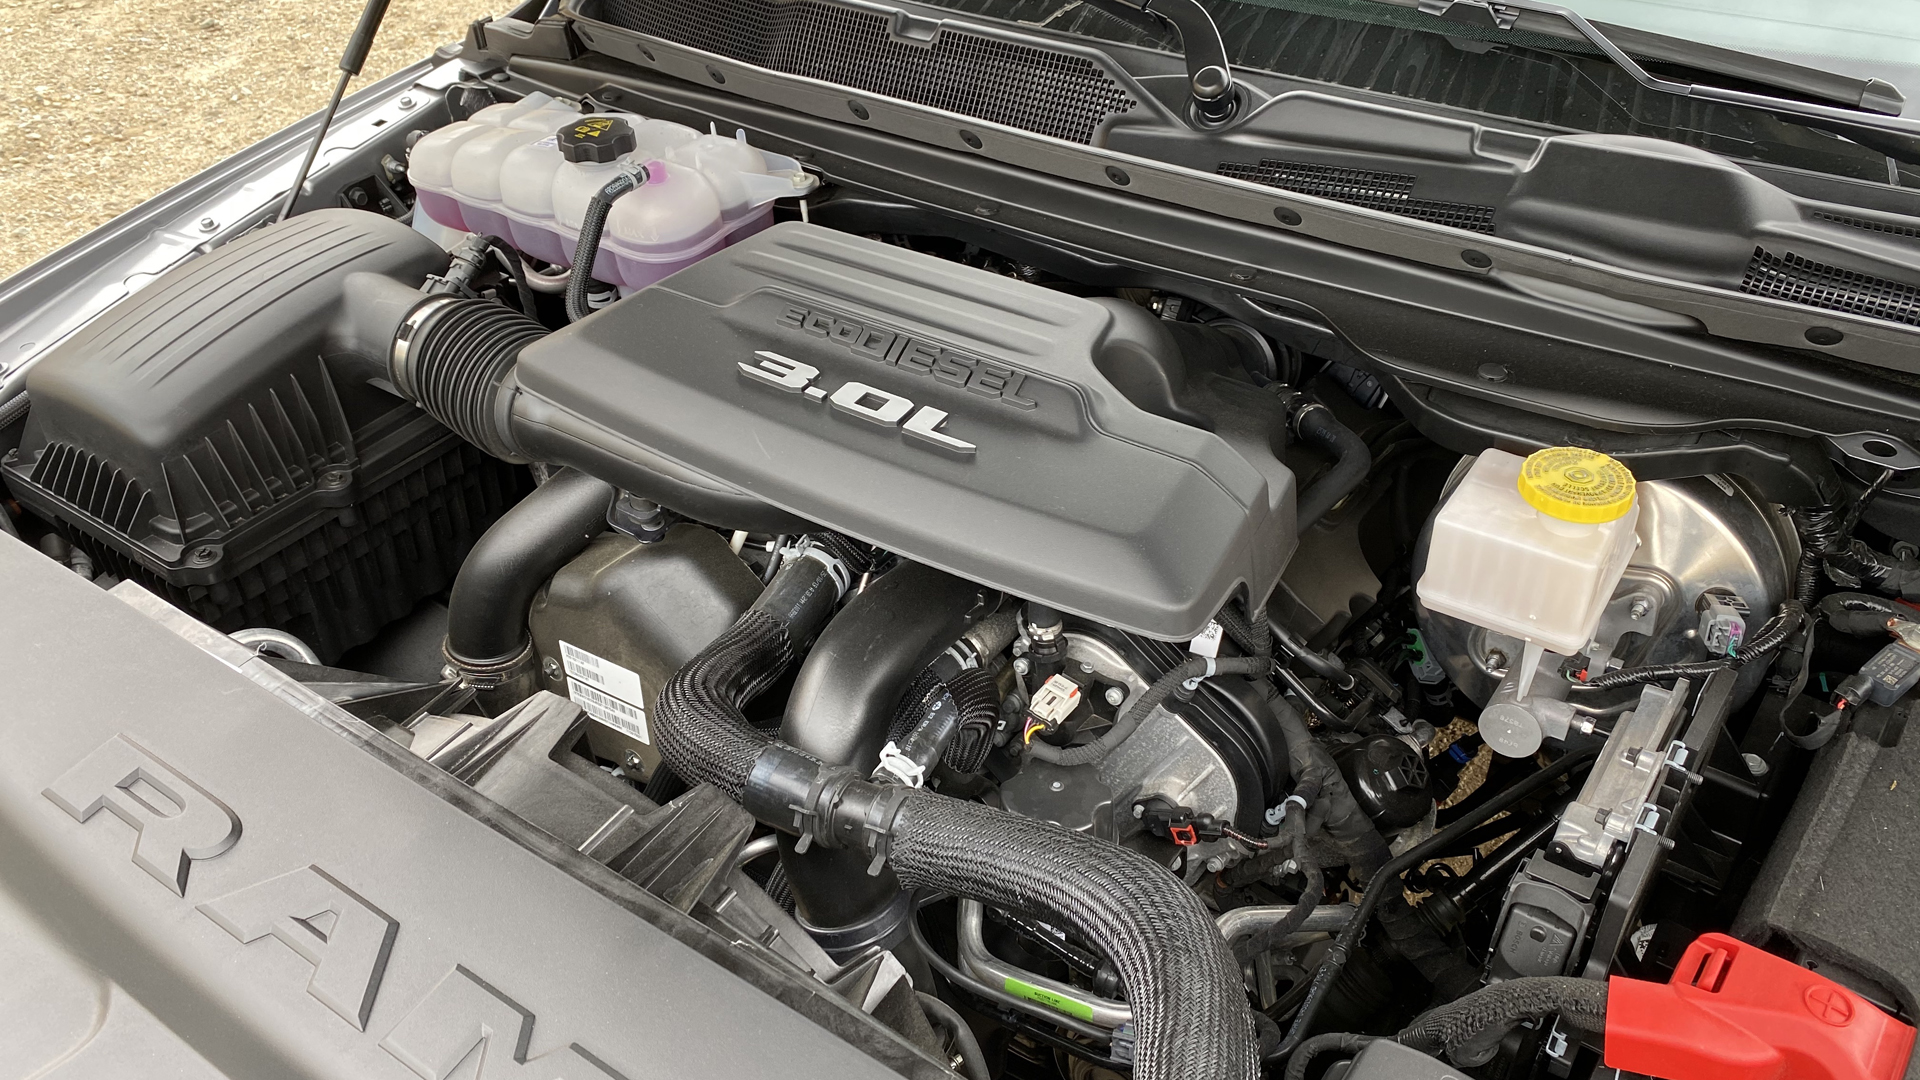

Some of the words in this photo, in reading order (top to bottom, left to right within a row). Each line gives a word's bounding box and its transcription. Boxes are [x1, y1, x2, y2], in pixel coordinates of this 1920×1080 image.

[737, 350, 977, 454] 3.0L
[776, 302, 1037, 411] ECODIESEL
[1510, 929, 1524, 954] BOSCH
